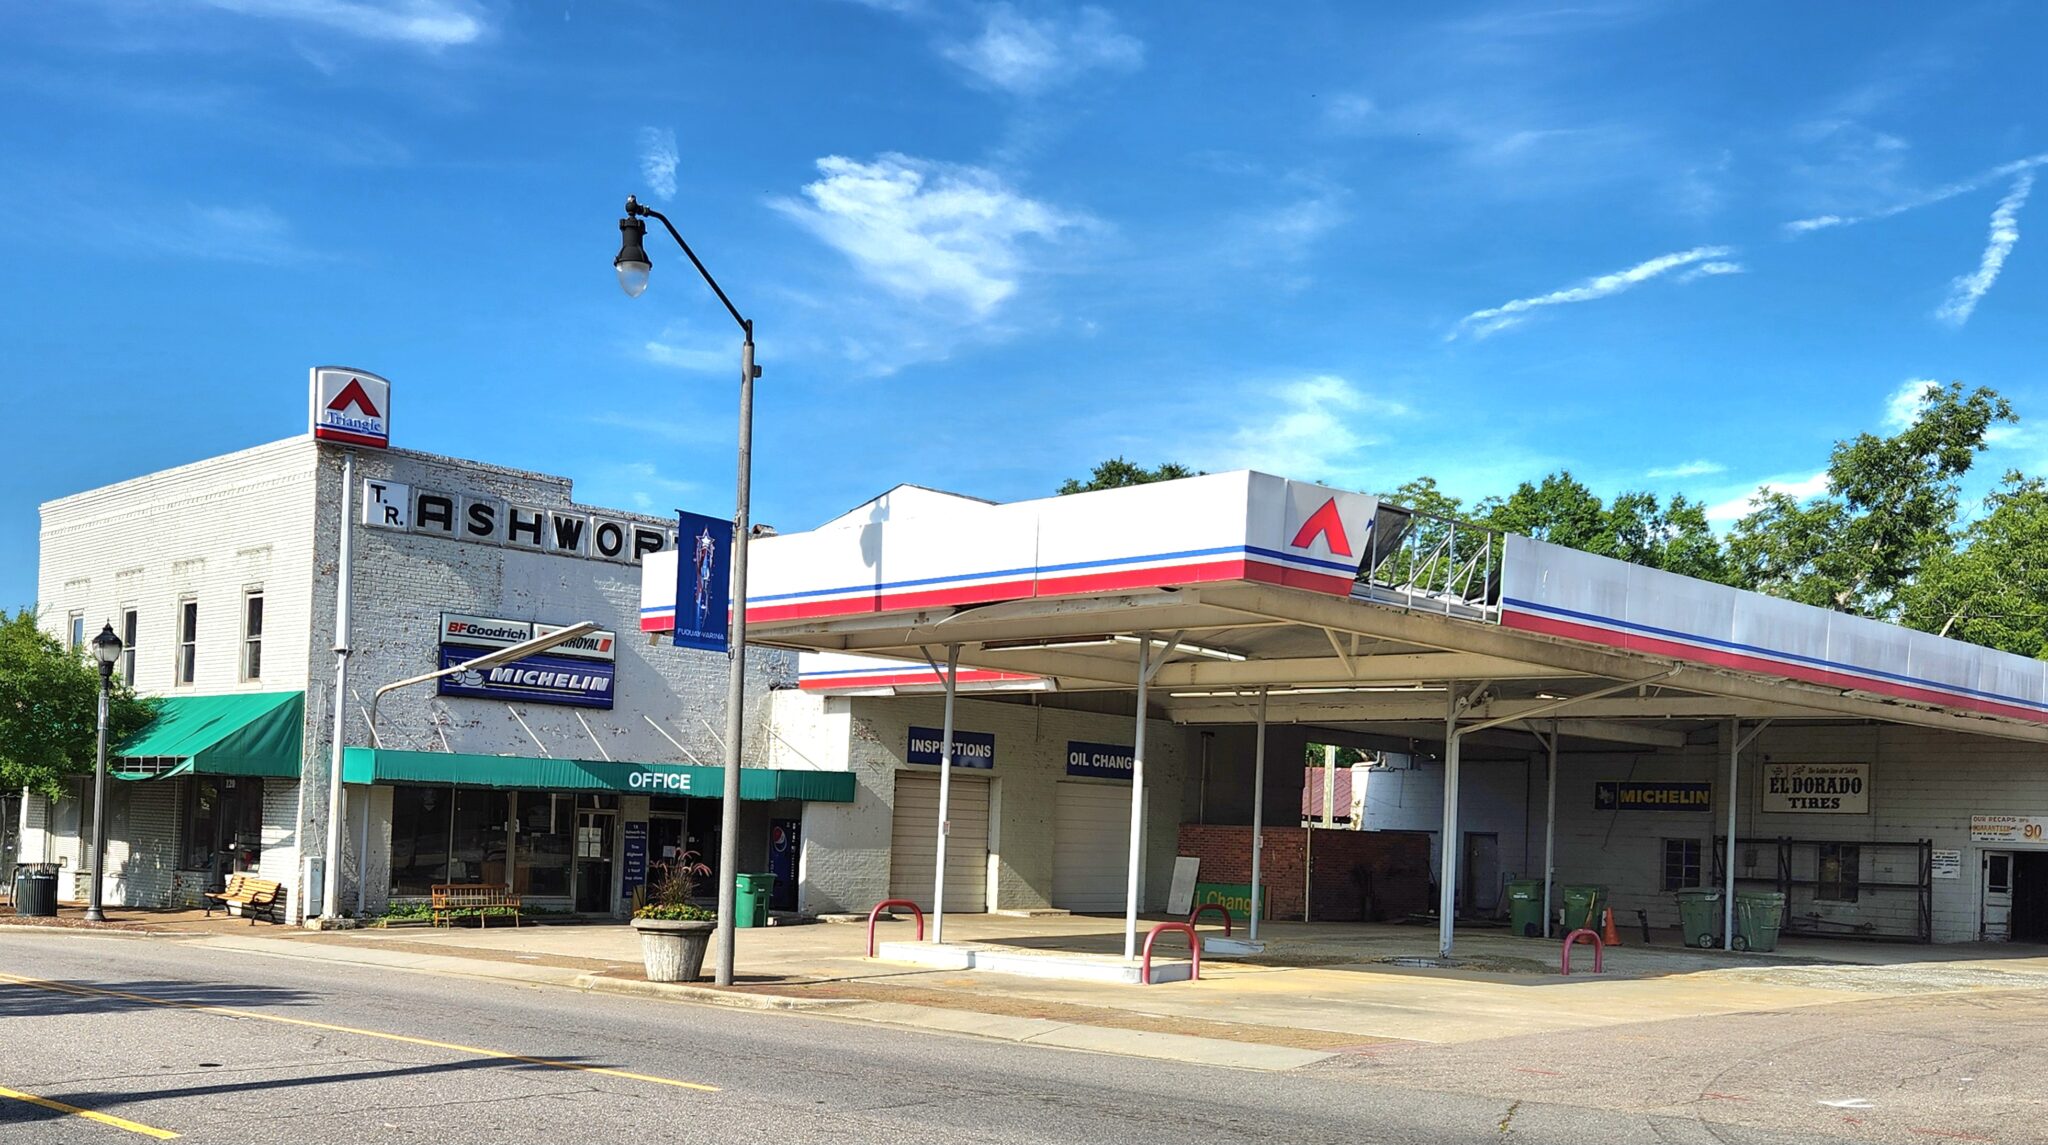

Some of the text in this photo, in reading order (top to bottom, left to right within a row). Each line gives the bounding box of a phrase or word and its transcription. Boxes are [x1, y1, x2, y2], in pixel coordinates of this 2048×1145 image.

[326, 411, 381, 433] Triangle
[417, 494, 678, 559] ASHWOR
[448, 622, 527, 640] BFGoodrich
[490, 668, 610, 691] MICHELIN
[1070, 752, 1135, 770] OIL CHANG
[629, 771, 691, 789] OFFICE
[1769, 777, 1862, 794] EL DORADO
[1621, 790, 1709, 804] MICHELIN
[1788, 797, 1841, 809] TIRES
[2024, 824, 2042, 838] 90
